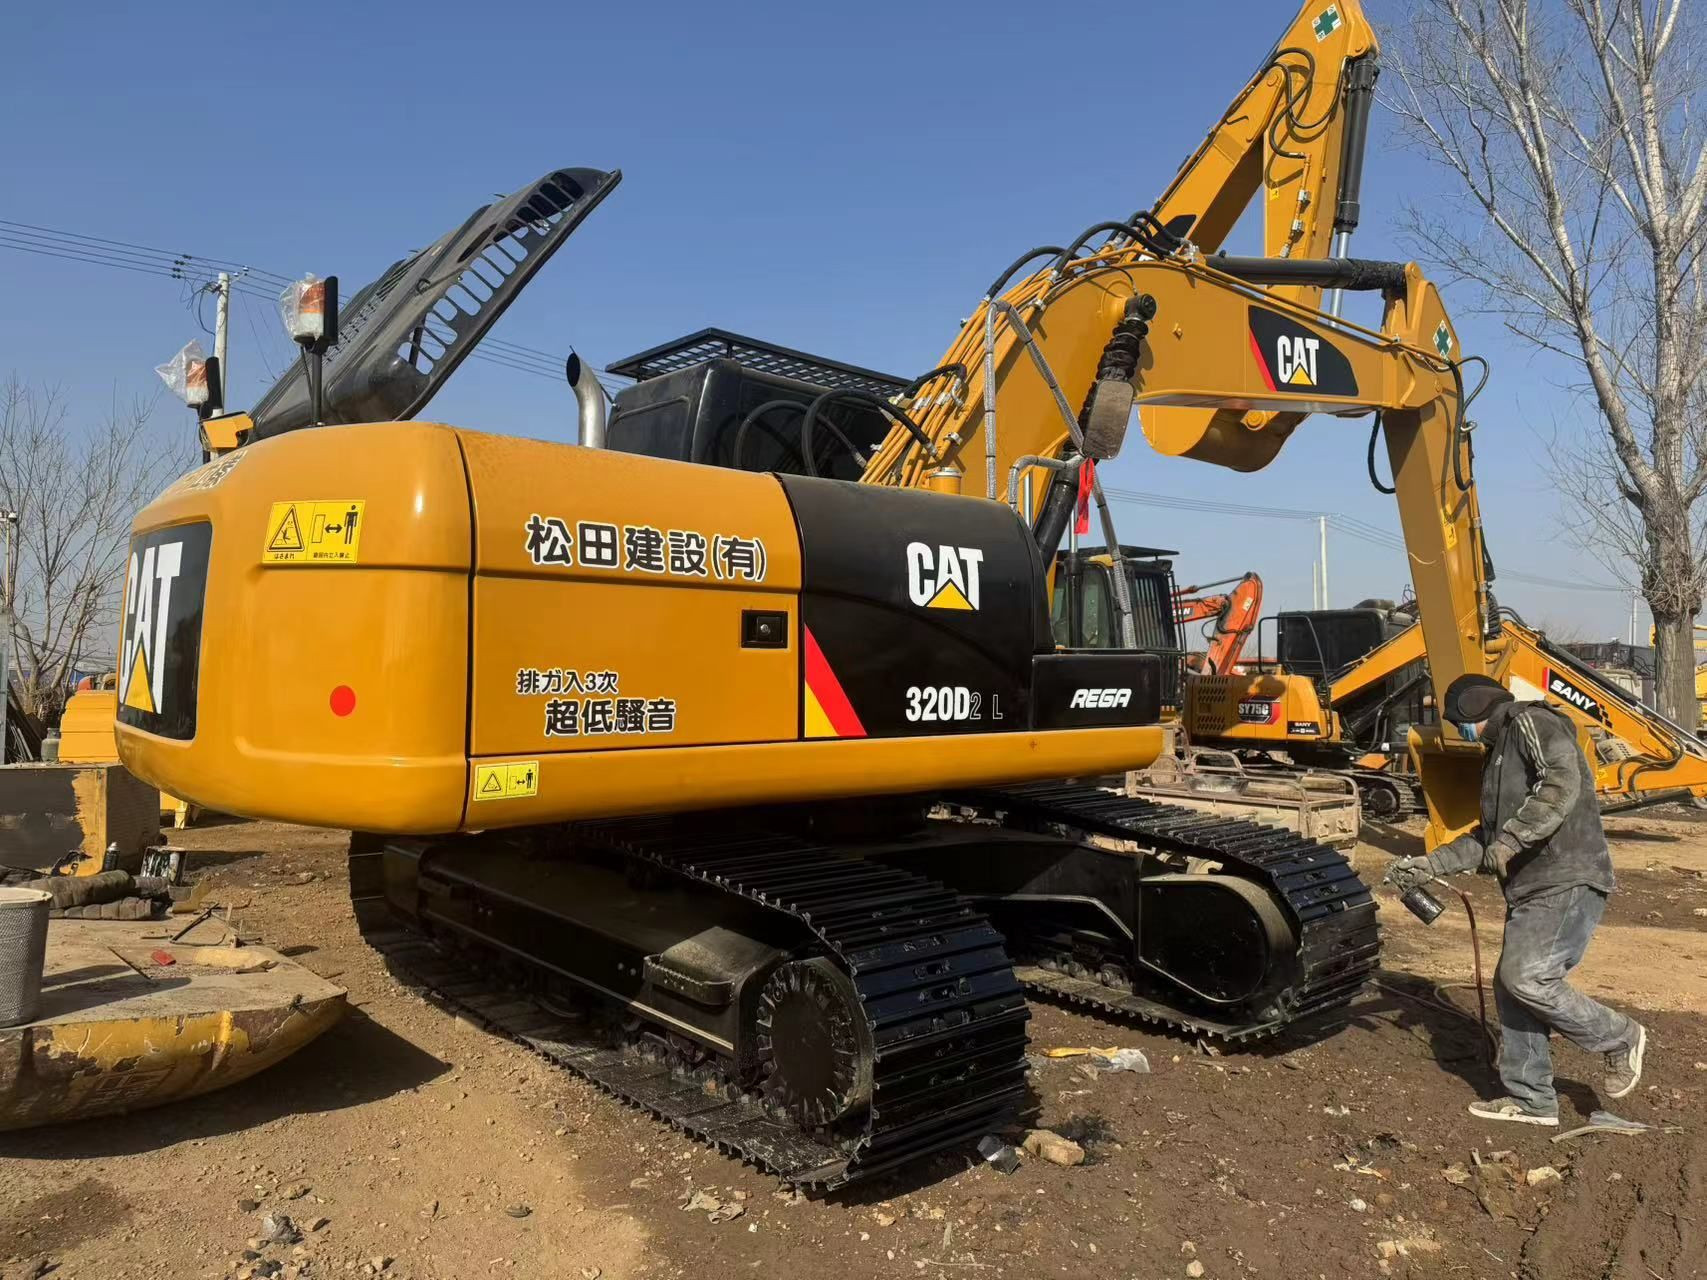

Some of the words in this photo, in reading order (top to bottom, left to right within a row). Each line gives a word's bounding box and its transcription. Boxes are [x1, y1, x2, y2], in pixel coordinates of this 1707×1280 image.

[1277, 335, 1320, 386] CAT
[526, 514, 767, 581] 松田建設(有)
[905, 541, 983, 611] CAT
[118, 541, 183, 714] CAT
[1070, 688, 1132, 708] REGA
[1238, 703, 1269, 715] SY75C
[1550, 679, 1596, 710] SANY
